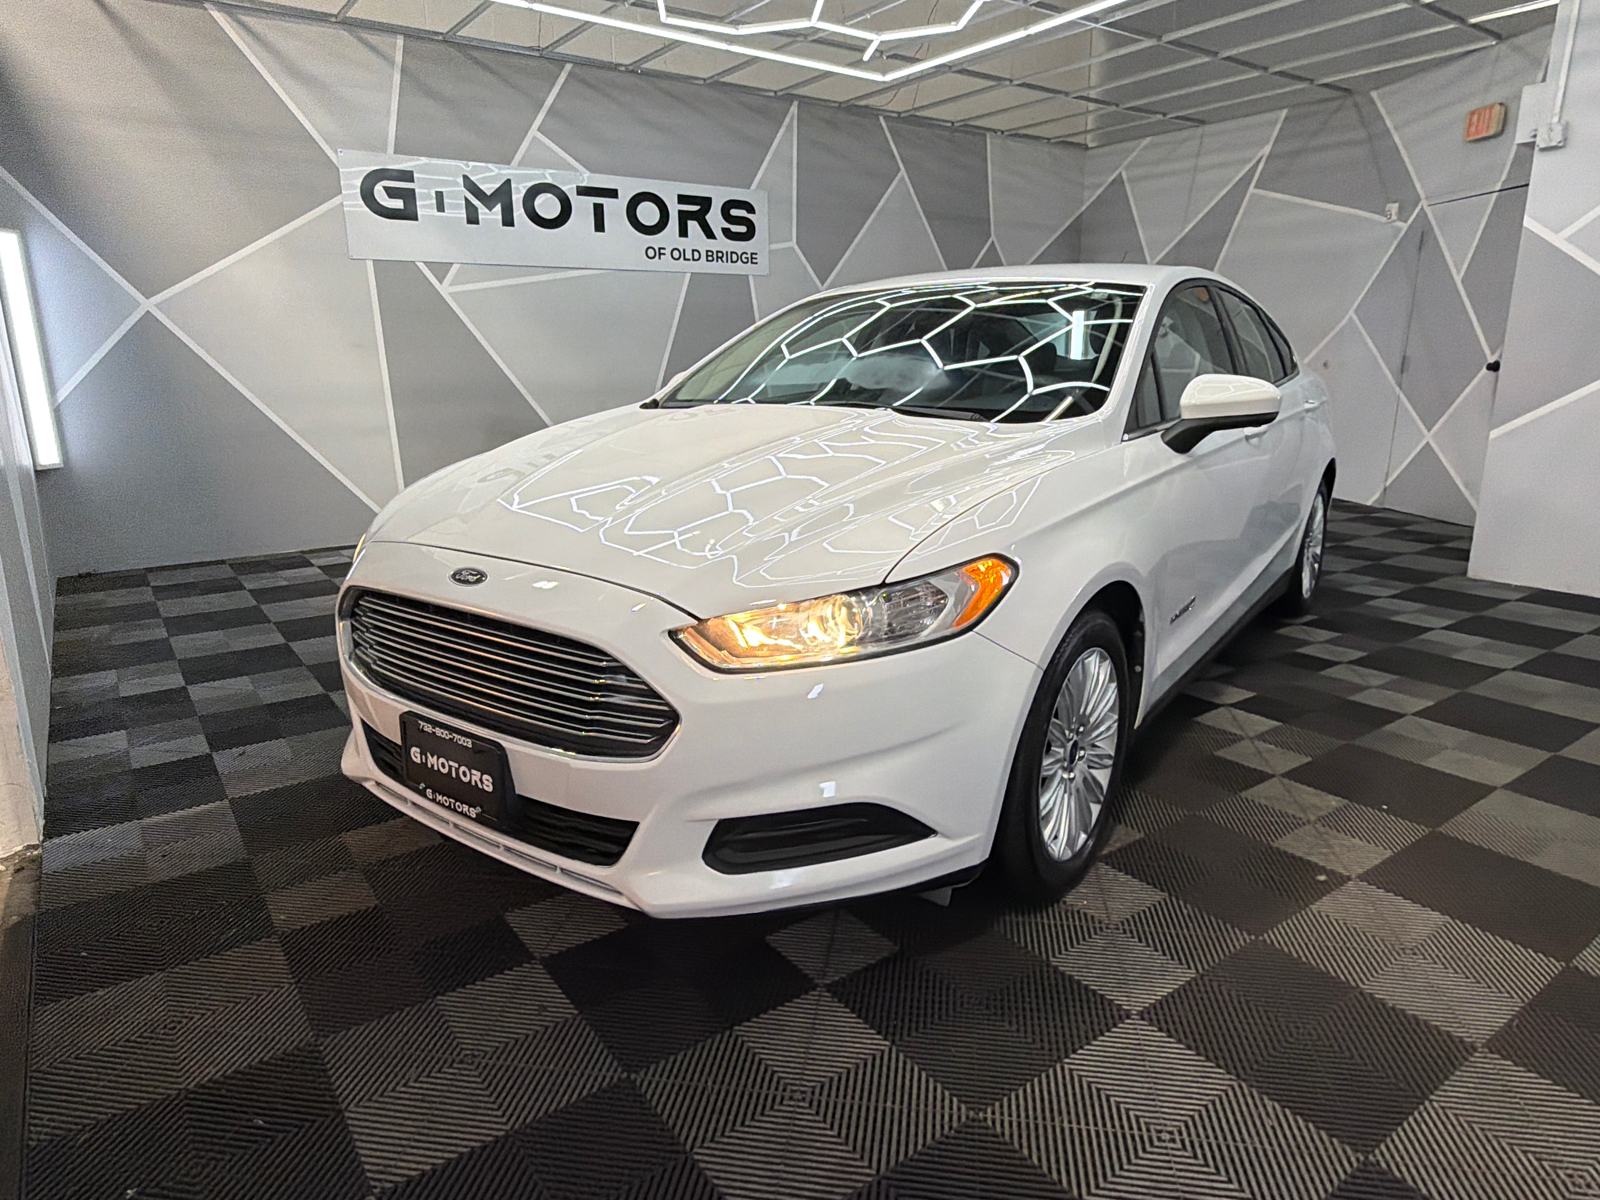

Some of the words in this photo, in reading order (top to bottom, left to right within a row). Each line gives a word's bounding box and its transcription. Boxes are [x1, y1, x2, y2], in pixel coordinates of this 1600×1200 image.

[645, 246, 667, 260] OF
[670, 247, 701, 262] OLD
[704, 250, 759, 265] BRIDGE
